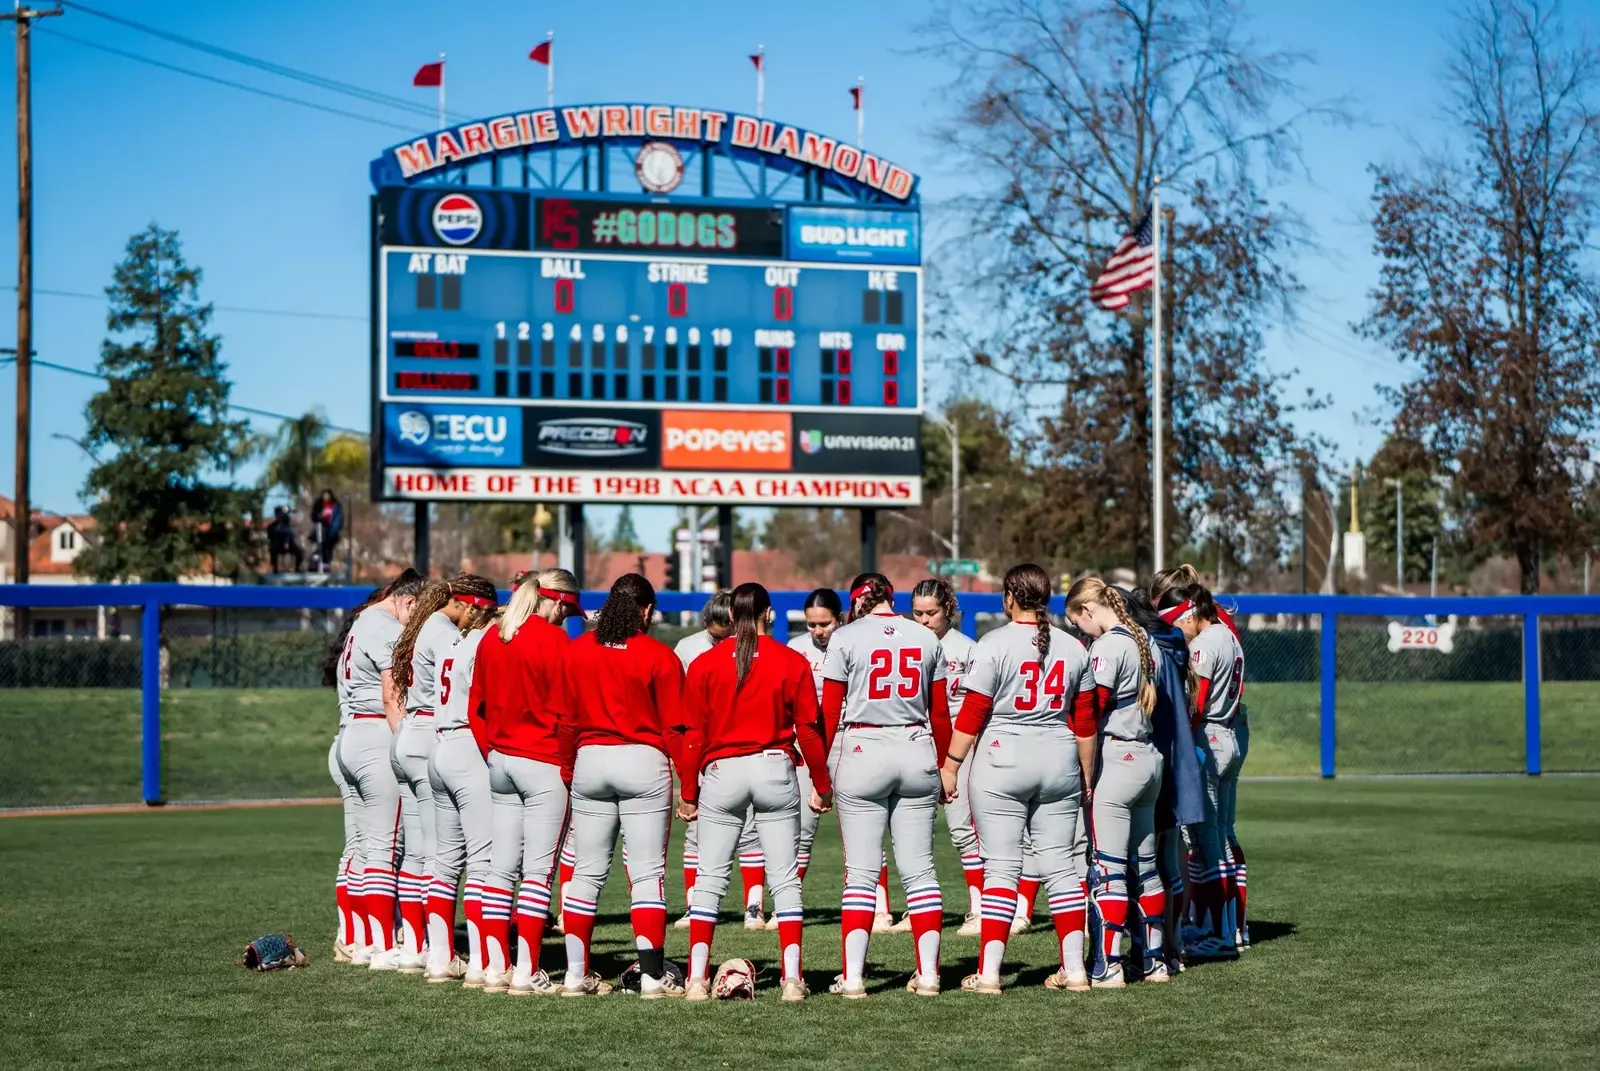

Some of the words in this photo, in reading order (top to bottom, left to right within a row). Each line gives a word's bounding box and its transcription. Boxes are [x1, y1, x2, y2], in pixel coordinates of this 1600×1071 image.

[394, 110, 560, 179] MARGIE
[562, 105, 728, 142] WRIGHT
[730, 115, 915, 200] DIAMOND
[438, 214, 478, 224] PEPSI
[592, 209, 736, 248] #GODOGS
[801, 225, 846, 245] BUD
[847, 227, 909, 248] LIGHT
[408, 253, 432, 274] AT
[434, 254, 469, 275] BAT
[541, 257, 586, 280] BALL
[647, 262, 710, 285] STRIKE
[764, 266, 801, 288] OUT
[555, 279, 575, 314] 0
[668, 283, 688, 317] 0
[773, 287, 793, 321] 0
[495, 321, 506, 340] 1
[517, 321, 530, 341] 2
[541, 322, 555, 341] 3
[569, 323, 582, 342] 4
[592, 323, 605, 343] 5
[616, 324, 629, 343] 6
[642, 325, 655, 344] 7
[711, 328, 733, 347] 10
[433, 414, 507, 443] EECU
[666, 427, 786, 453] POPEYES
[395, 473, 476, 493] HOME
[487, 475, 521, 494] OF
[529, 475, 581, 494] THE
[593, 476, 660, 496] 1998
[673, 478, 745, 497] NCAA
[755, 479, 911, 499] CHAMPIONS
[1402, 630, 1438, 645] 220
[439, 657, 455, 706] 5
[867, 646, 923, 700] 25
[1013, 659, 1067, 712] 34
